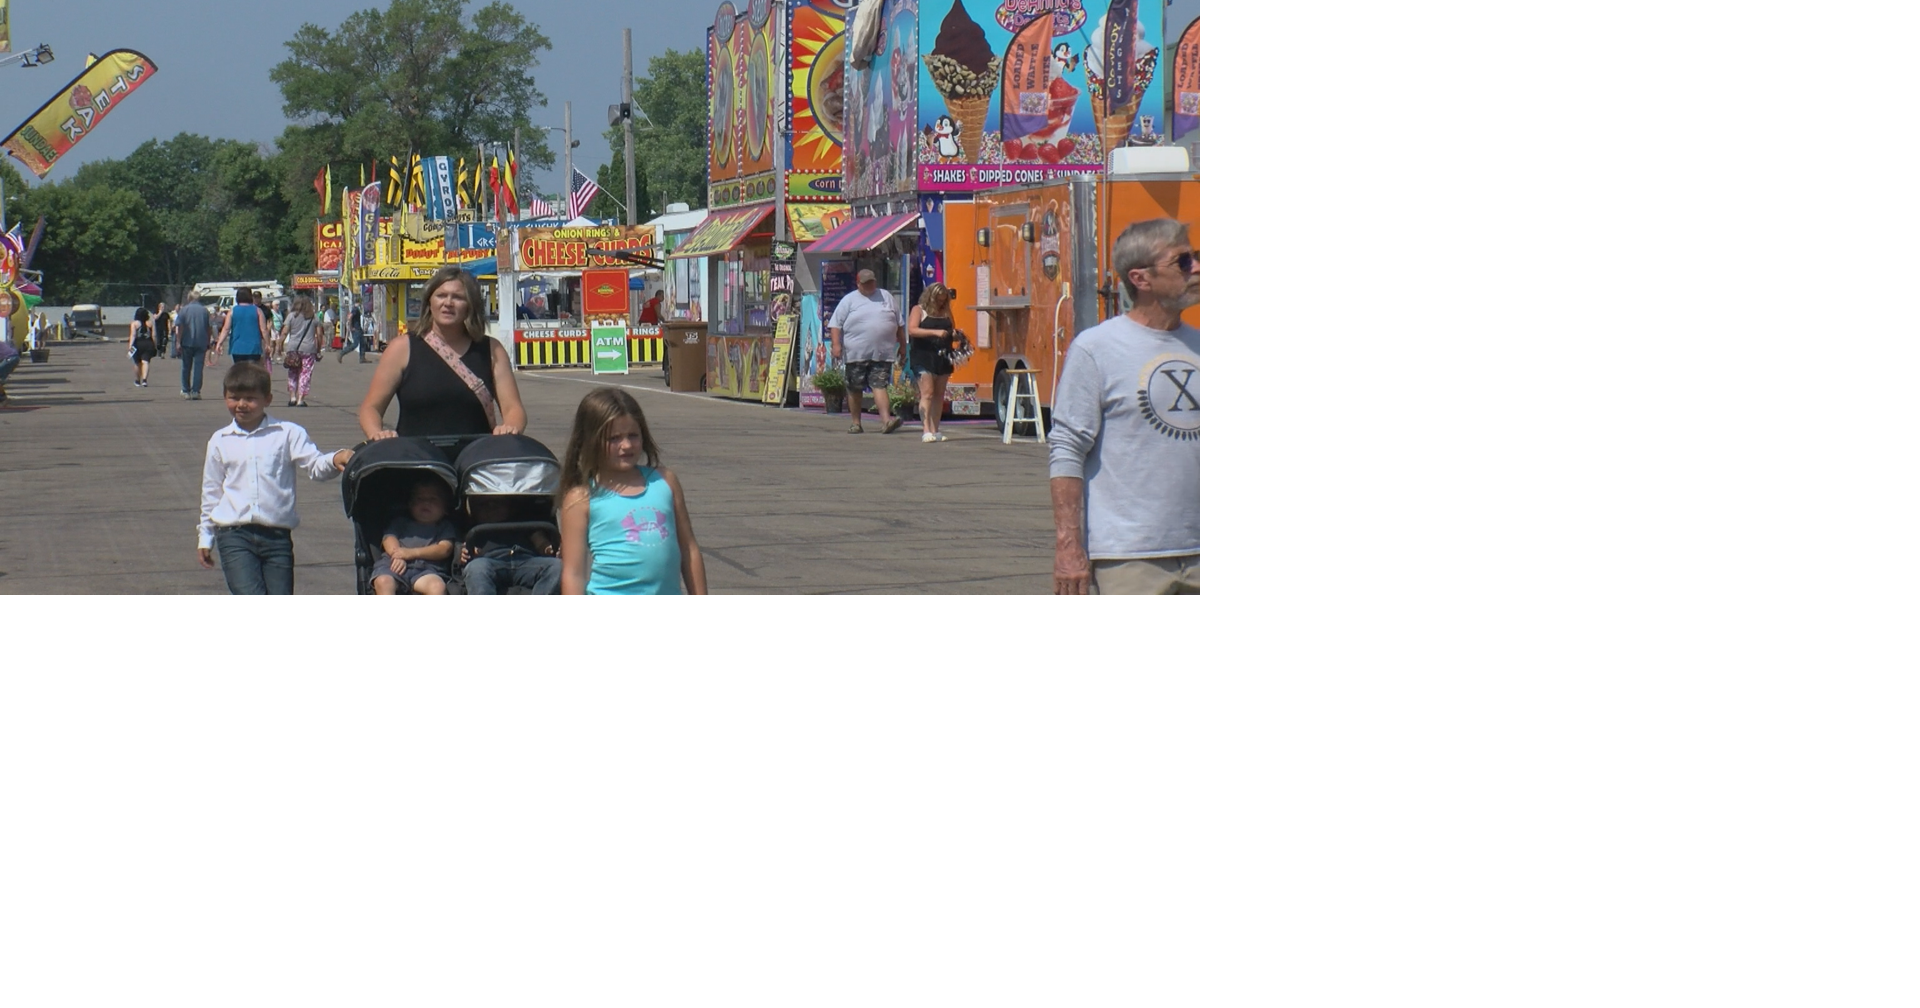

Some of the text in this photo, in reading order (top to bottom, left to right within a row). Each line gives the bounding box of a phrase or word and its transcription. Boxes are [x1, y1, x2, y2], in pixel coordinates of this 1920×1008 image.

[1012, 43, 1025, 89] LOADED
[60, 64, 145, 142] STEAK
[933, 169, 966, 183] SHAKES
[979, 169, 1044, 183] DIPPED CONES
[437, 162, 457, 219] GYROS
[364, 212, 376, 261] GYROS
[554, 228, 620, 239] ONION RINGS &
[405, 248, 439, 259] DONUT
[522, 237, 587, 267] CHEESE
[523, 329, 587, 339] CHEESE CURDS
[632, 327, 660, 336] RINGS
[596, 337, 624, 347] ATM
[1160, 369, 1200, 412] X
